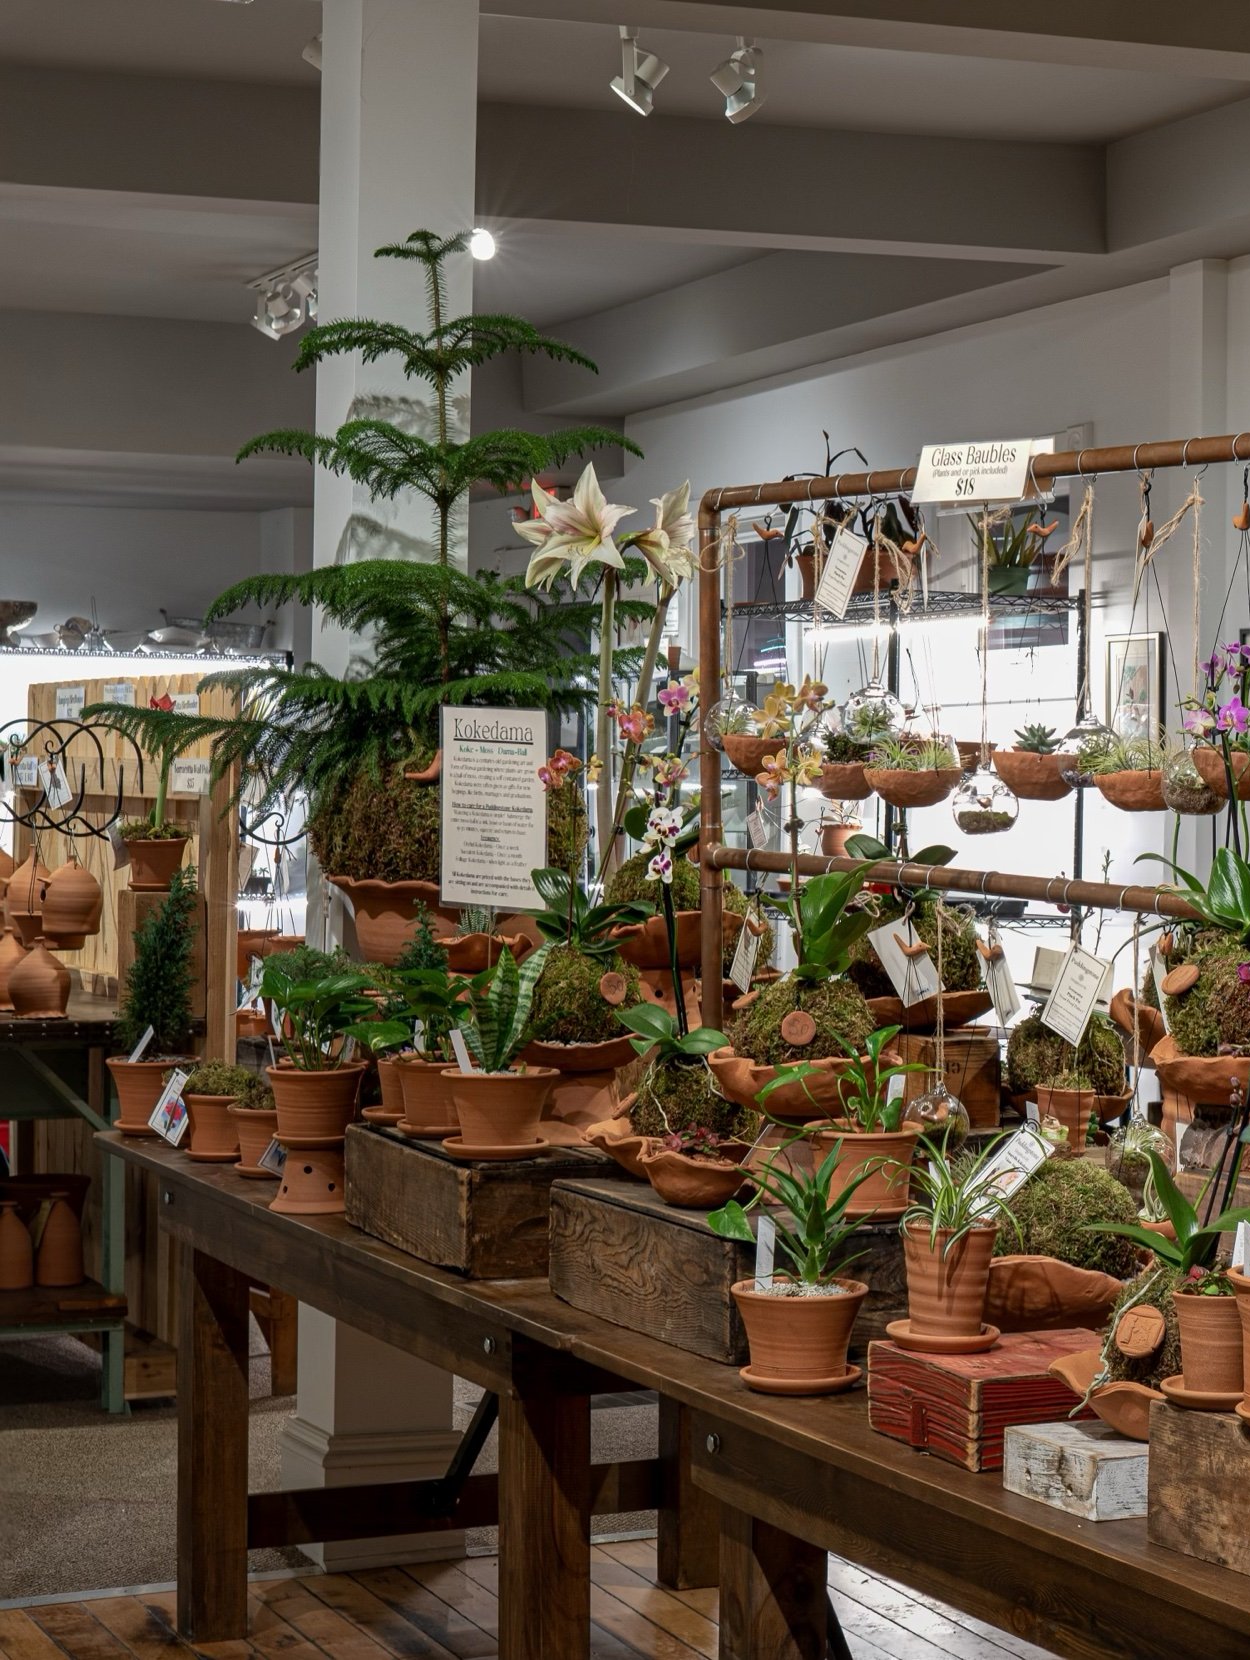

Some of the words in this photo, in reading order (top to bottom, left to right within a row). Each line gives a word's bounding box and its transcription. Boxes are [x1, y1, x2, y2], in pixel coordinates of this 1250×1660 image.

[931, 447, 963, 467] Glass
[966, 443, 1017, 465] Baubles
[955, 477, 976, 496] $18
[454, 718, 534, 742] Kokedama
